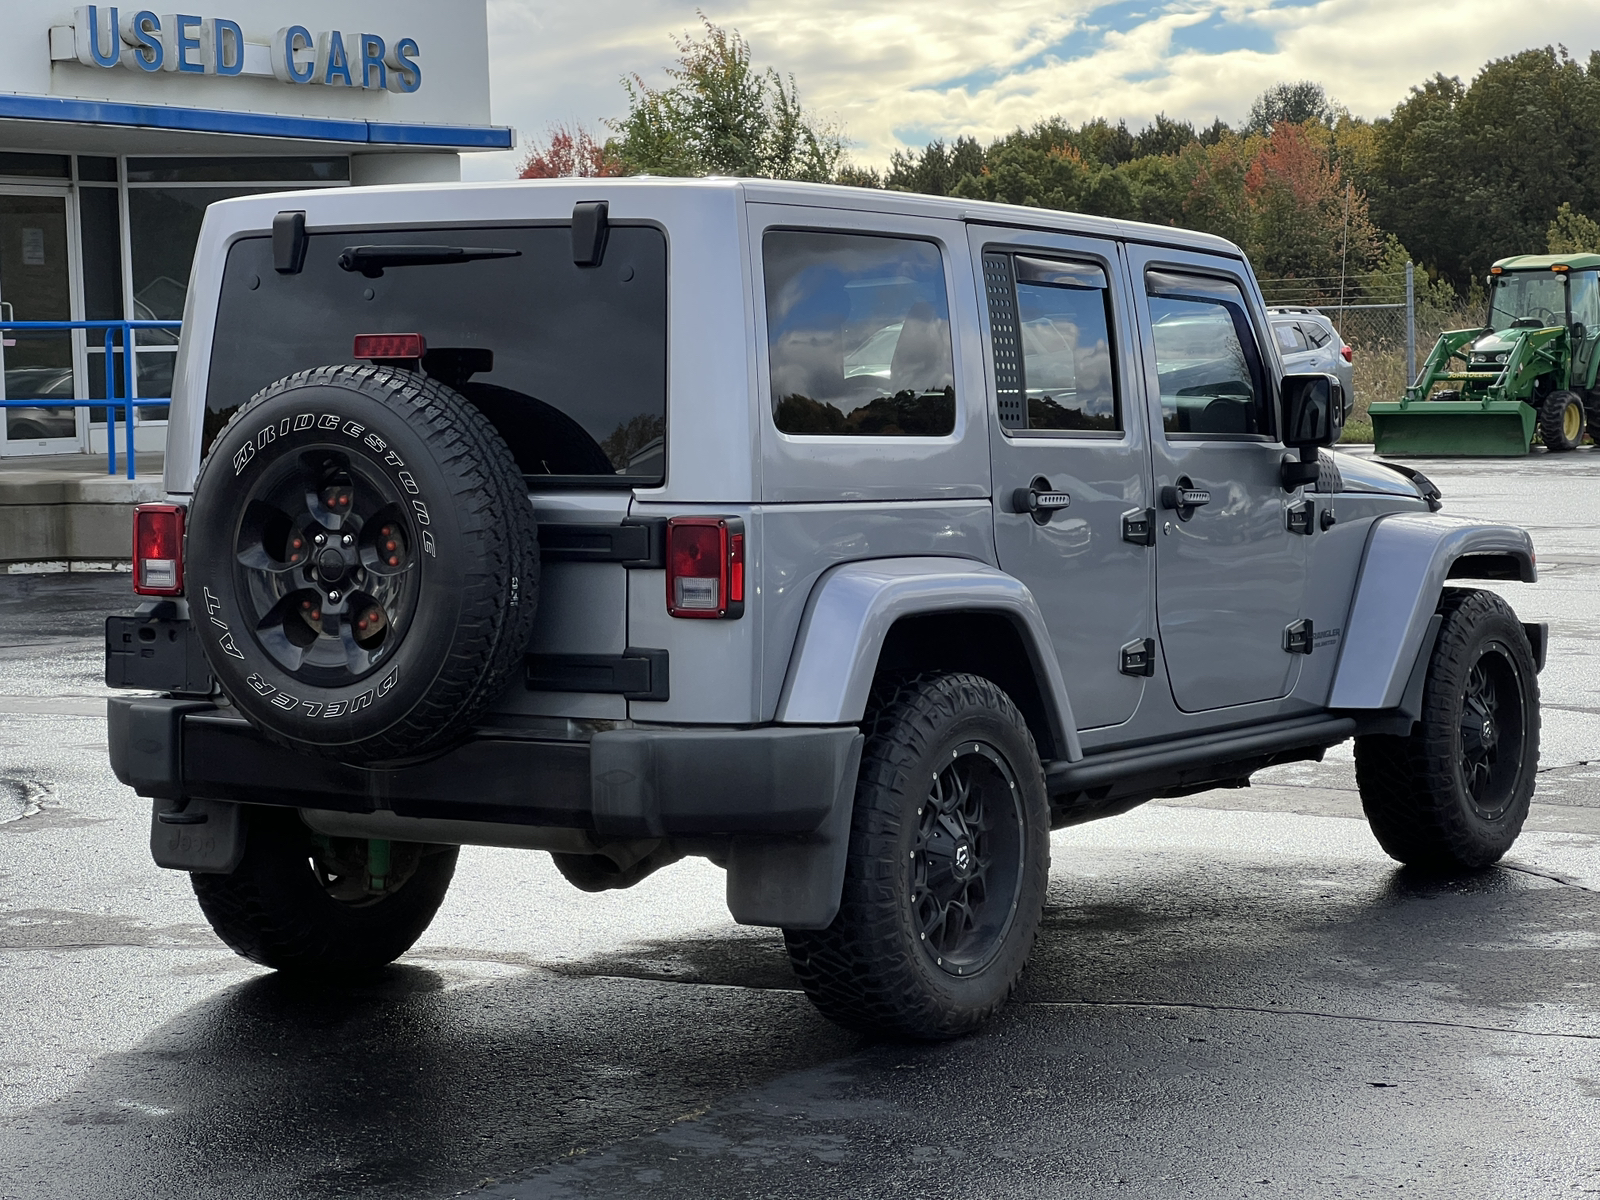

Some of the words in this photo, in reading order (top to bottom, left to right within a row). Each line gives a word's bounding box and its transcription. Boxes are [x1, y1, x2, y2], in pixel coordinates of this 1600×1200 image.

[74, 5, 245, 76] USED
[272, 25, 422, 94] CARS
[232, 413, 436, 557] BRIDGESTONE
[204, 587, 245, 660] A/T
[1313, 628, 1340, 640] RANGLER
[246, 665, 399, 718] DUELER
